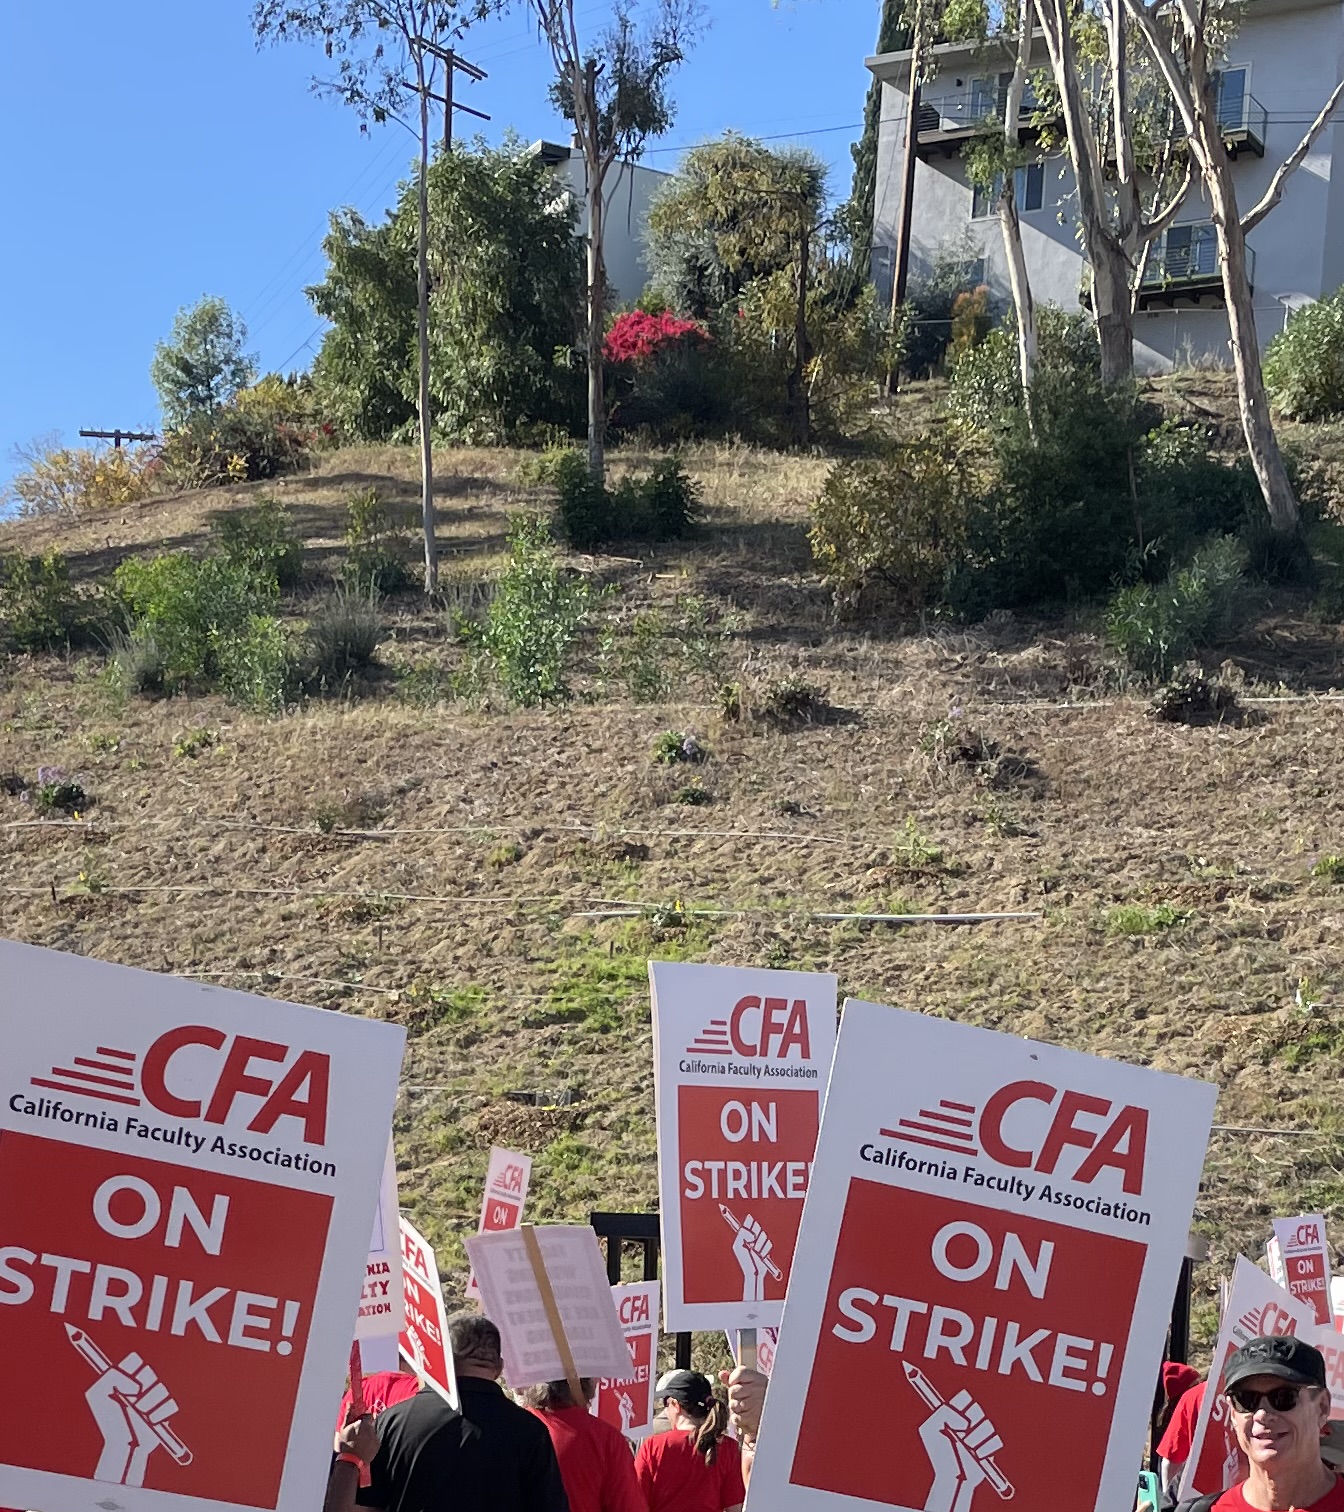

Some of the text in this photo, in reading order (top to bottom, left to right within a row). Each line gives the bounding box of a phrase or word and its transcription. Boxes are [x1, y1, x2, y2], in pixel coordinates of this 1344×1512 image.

[730, 995, 811, 1059] CFA
[140, 1024, 331, 1146] CFA
[679, 1060, 818, 1079] California Faculty Association
[8, 1094, 337, 1178] California Faculty Association
[720, 1100, 778, 1143] ON
[979, 1080, 1149, 1196] CFA
[504, 1163, 524, 1193] CFA
[859, 1144, 1151, 1226] California Faculty Association
[92, 1174, 231, 1256] ON
[493, 1205, 507, 1226] ON
[1296, 1224, 1320, 1247] CFA
[931, 1220, 1055, 1300] ON
[1297, 1259, 1314, 1274] ON
[1290, 1276, 1325, 1295] STRIKE!
[619, 1294, 650, 1325] CFA
[1259, 1302, 1298, 1337] CFA
[831, 1286, 1114, 1397] STRIKE!
